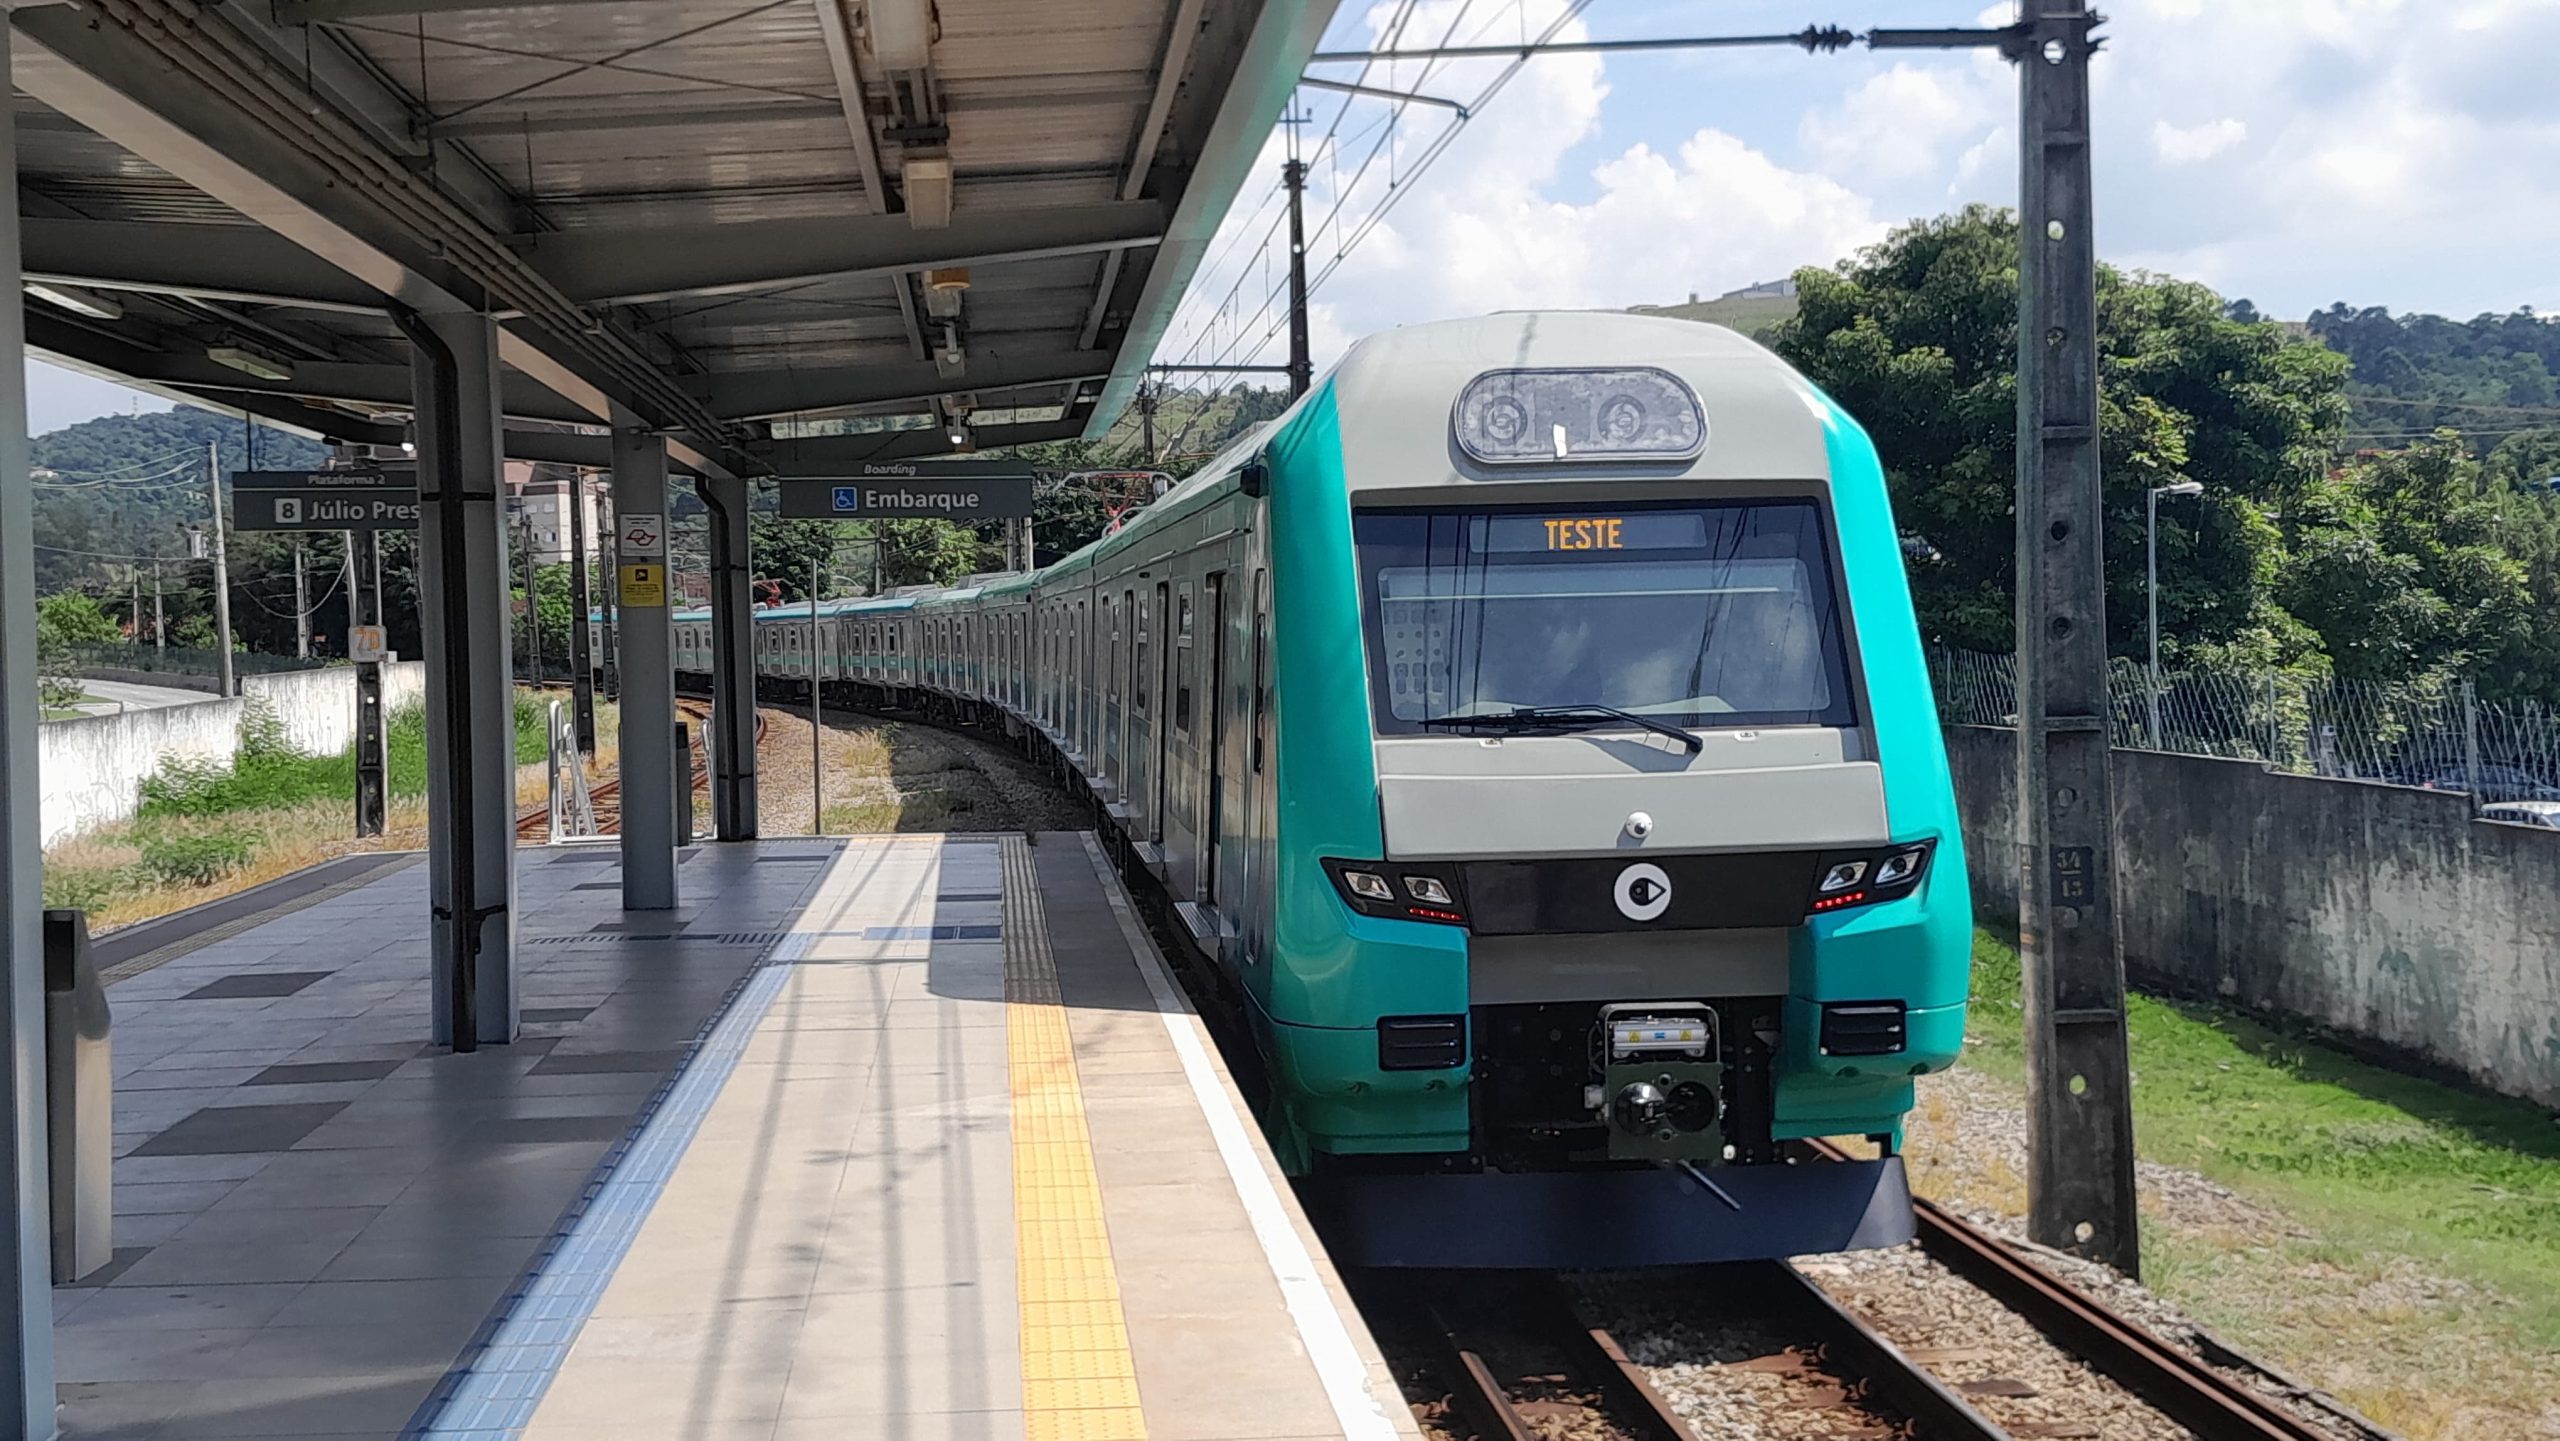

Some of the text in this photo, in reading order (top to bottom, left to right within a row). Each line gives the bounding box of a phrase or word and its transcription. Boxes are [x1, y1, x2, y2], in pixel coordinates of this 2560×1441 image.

[308, 474, 386, 485] Plataforma 2
[864, 464, 916, 476] Boarding
[282, 500, 420, 520] 8 Júlio Pres
[865, 489, 980, 512] Embarque
[1544, 519, 1623, 550] TESTE
